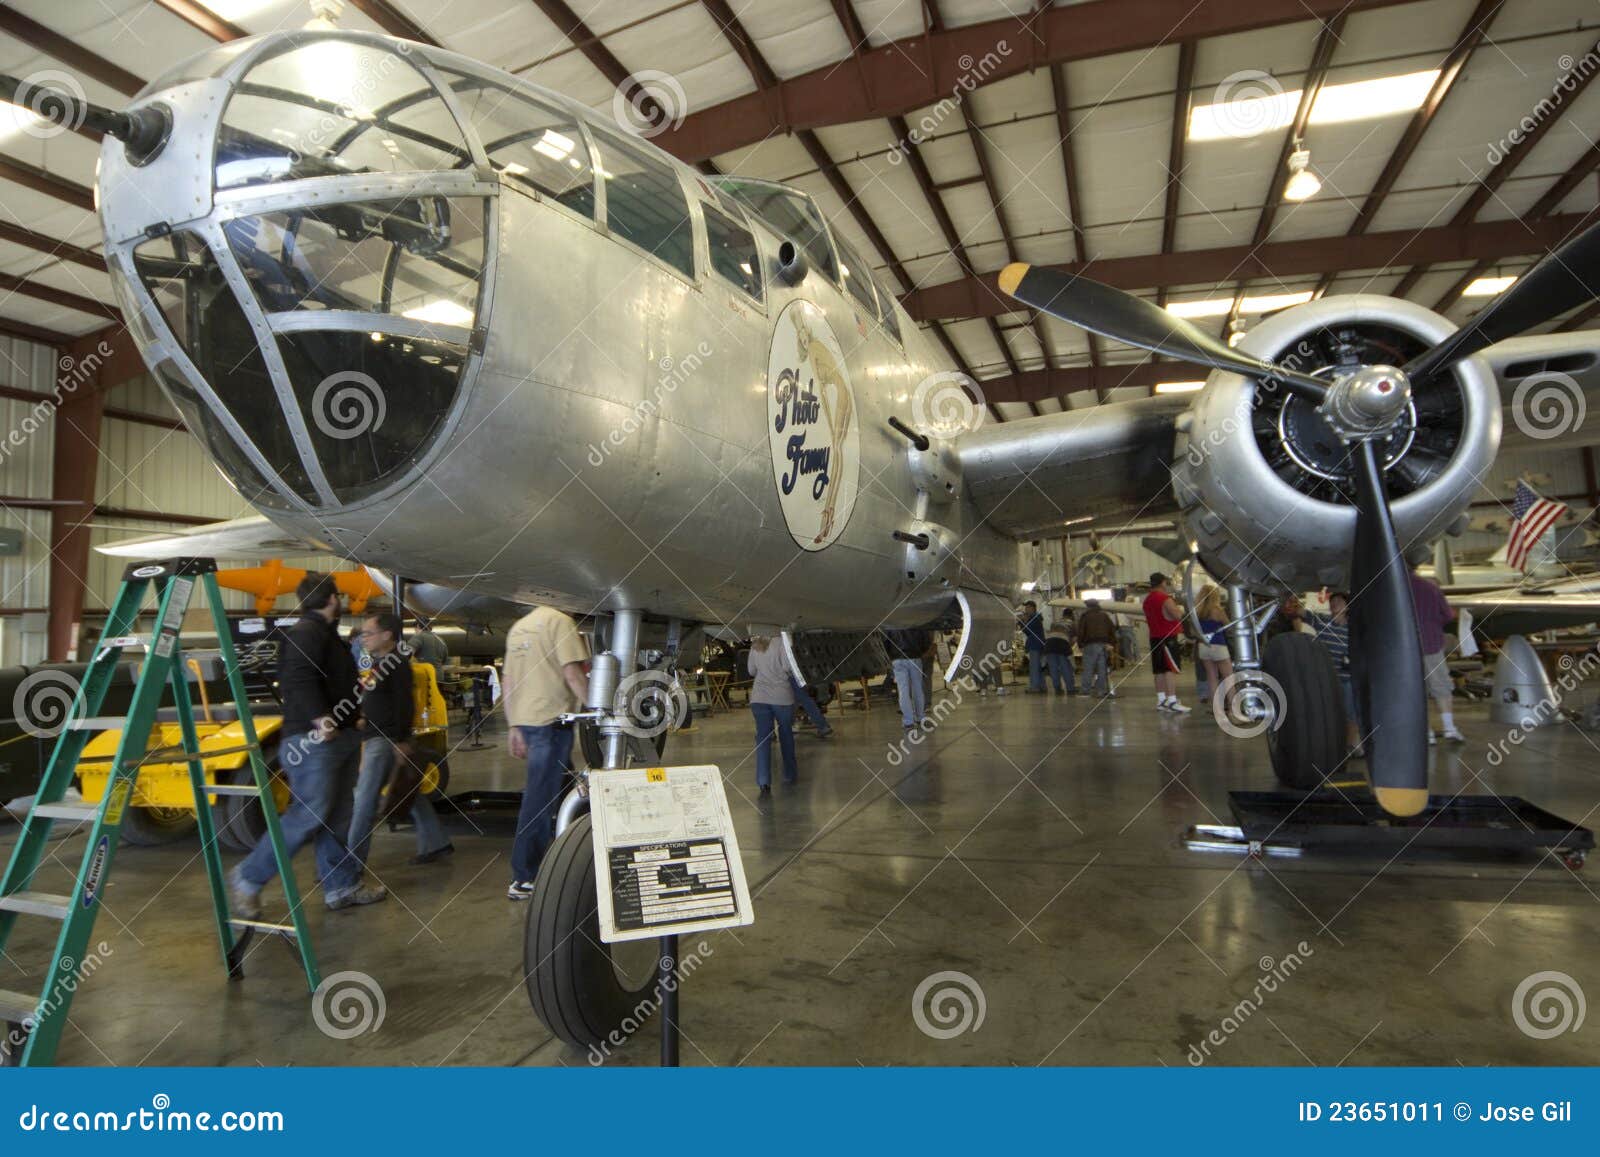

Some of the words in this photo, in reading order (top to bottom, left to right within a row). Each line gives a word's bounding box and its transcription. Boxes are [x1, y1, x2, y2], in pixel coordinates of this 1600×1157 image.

[775, 368, 820, 433] Photo
[782, 429, 830, 500] Fanny
[639, 841, 688, 851] SPECIFICATIONS
